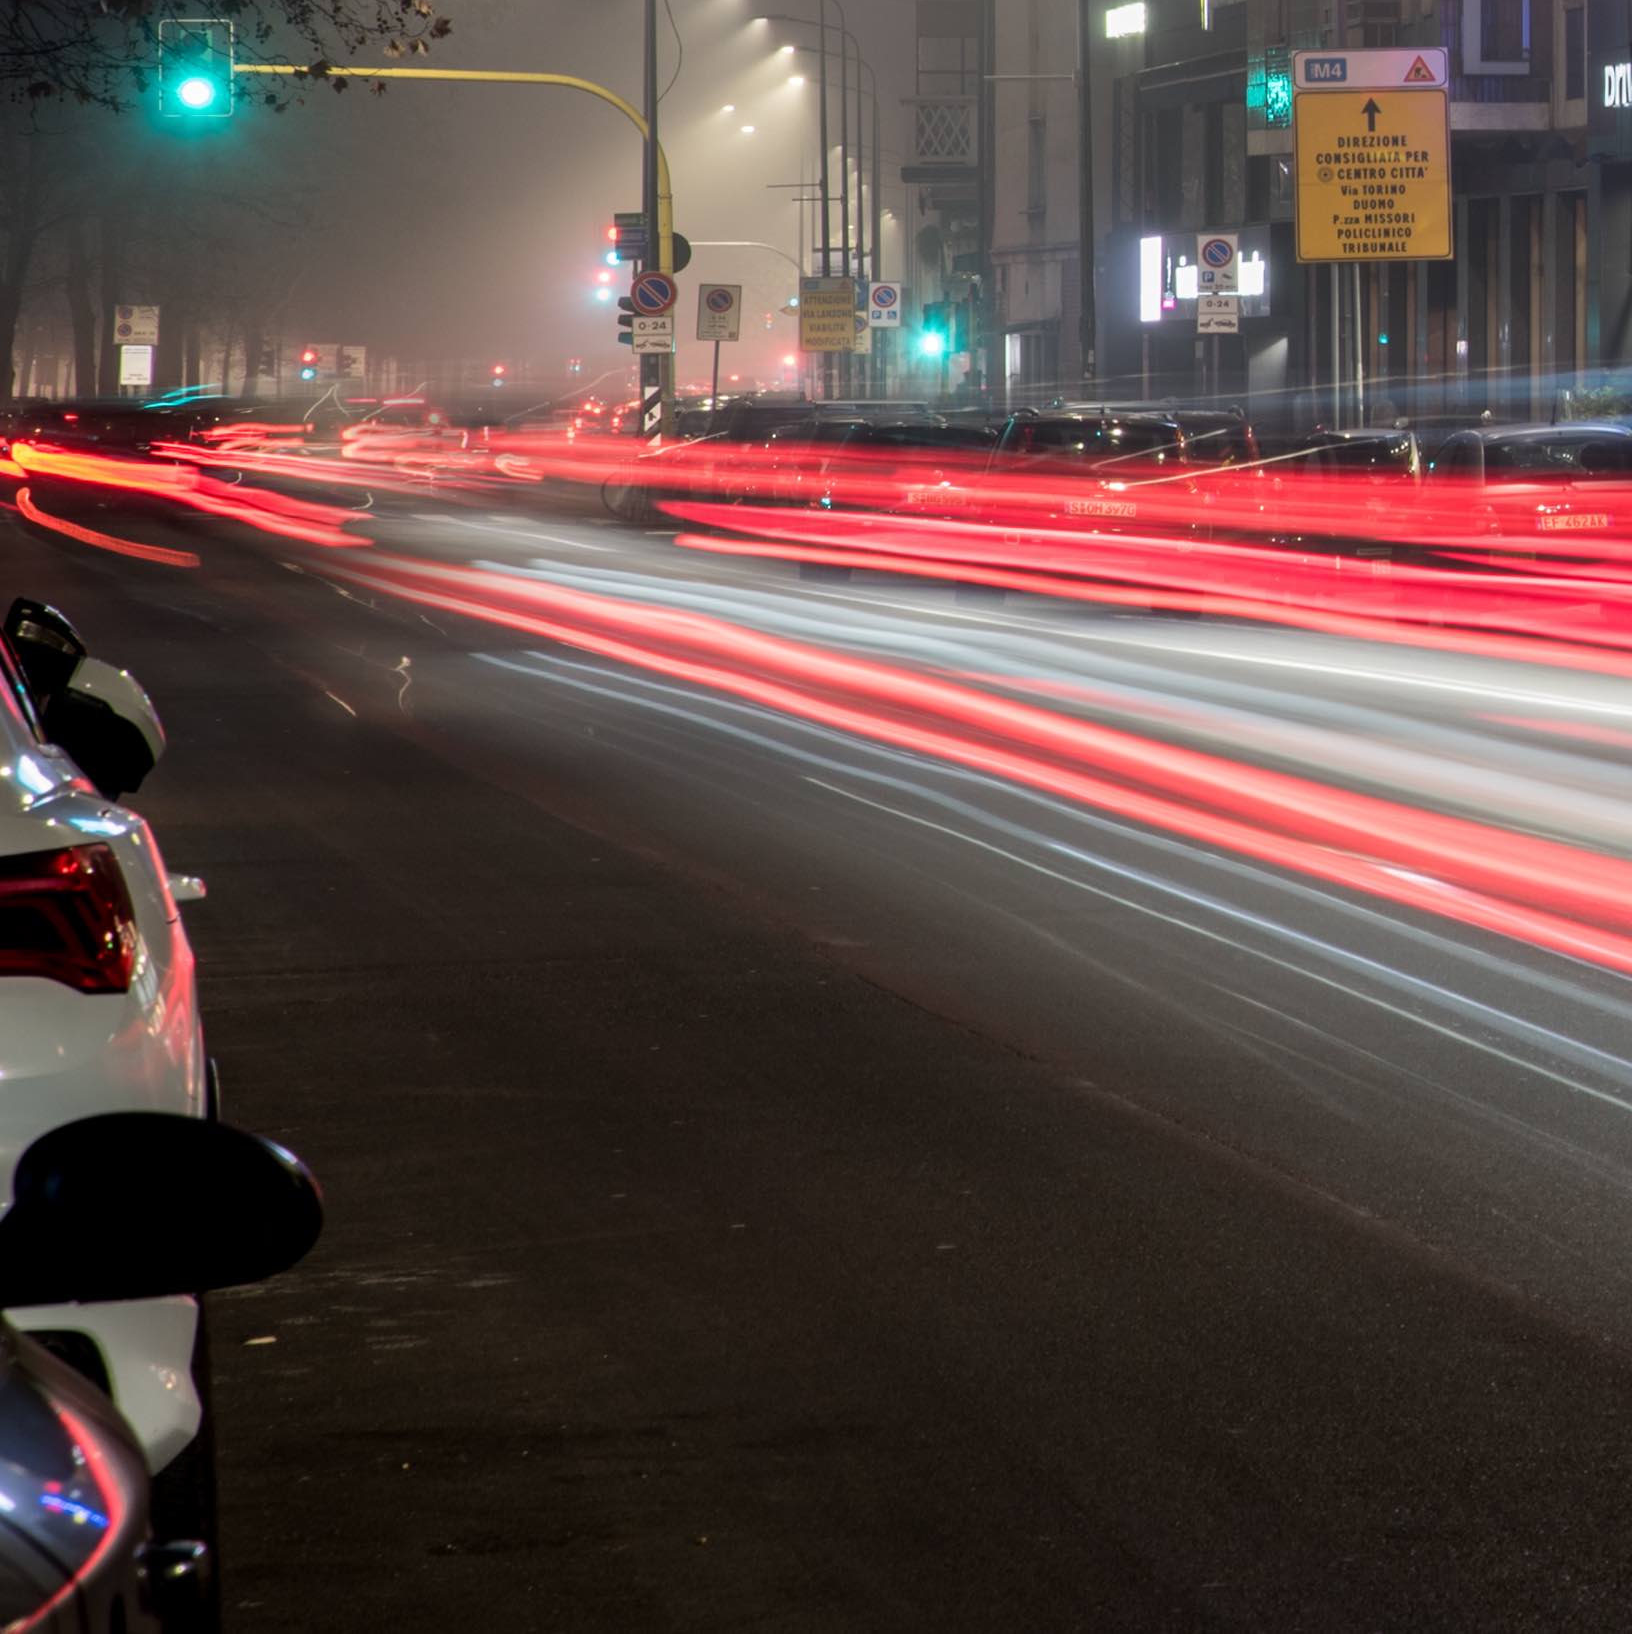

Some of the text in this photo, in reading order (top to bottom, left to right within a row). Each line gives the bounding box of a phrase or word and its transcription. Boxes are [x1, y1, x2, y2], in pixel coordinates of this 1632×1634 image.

[1337, 135, 1408, 148] DIREZIONE
[1316, 151, 1429, 165] CONSIGLIATA PER
[1337, 167, 1428, 180] CENTRO CITTA'
[1341, 184, 1406, 196] Via TORINO
[1353, 199, 1394, 210] DUOMO
[1364, 213, 1415, 224] MISSORI
[1337, 227, 1412, 239] POLICLINICO
[1342, 242, 1408, 253] TRIBUNALE
[638, 321, 667, 331] 0-24
